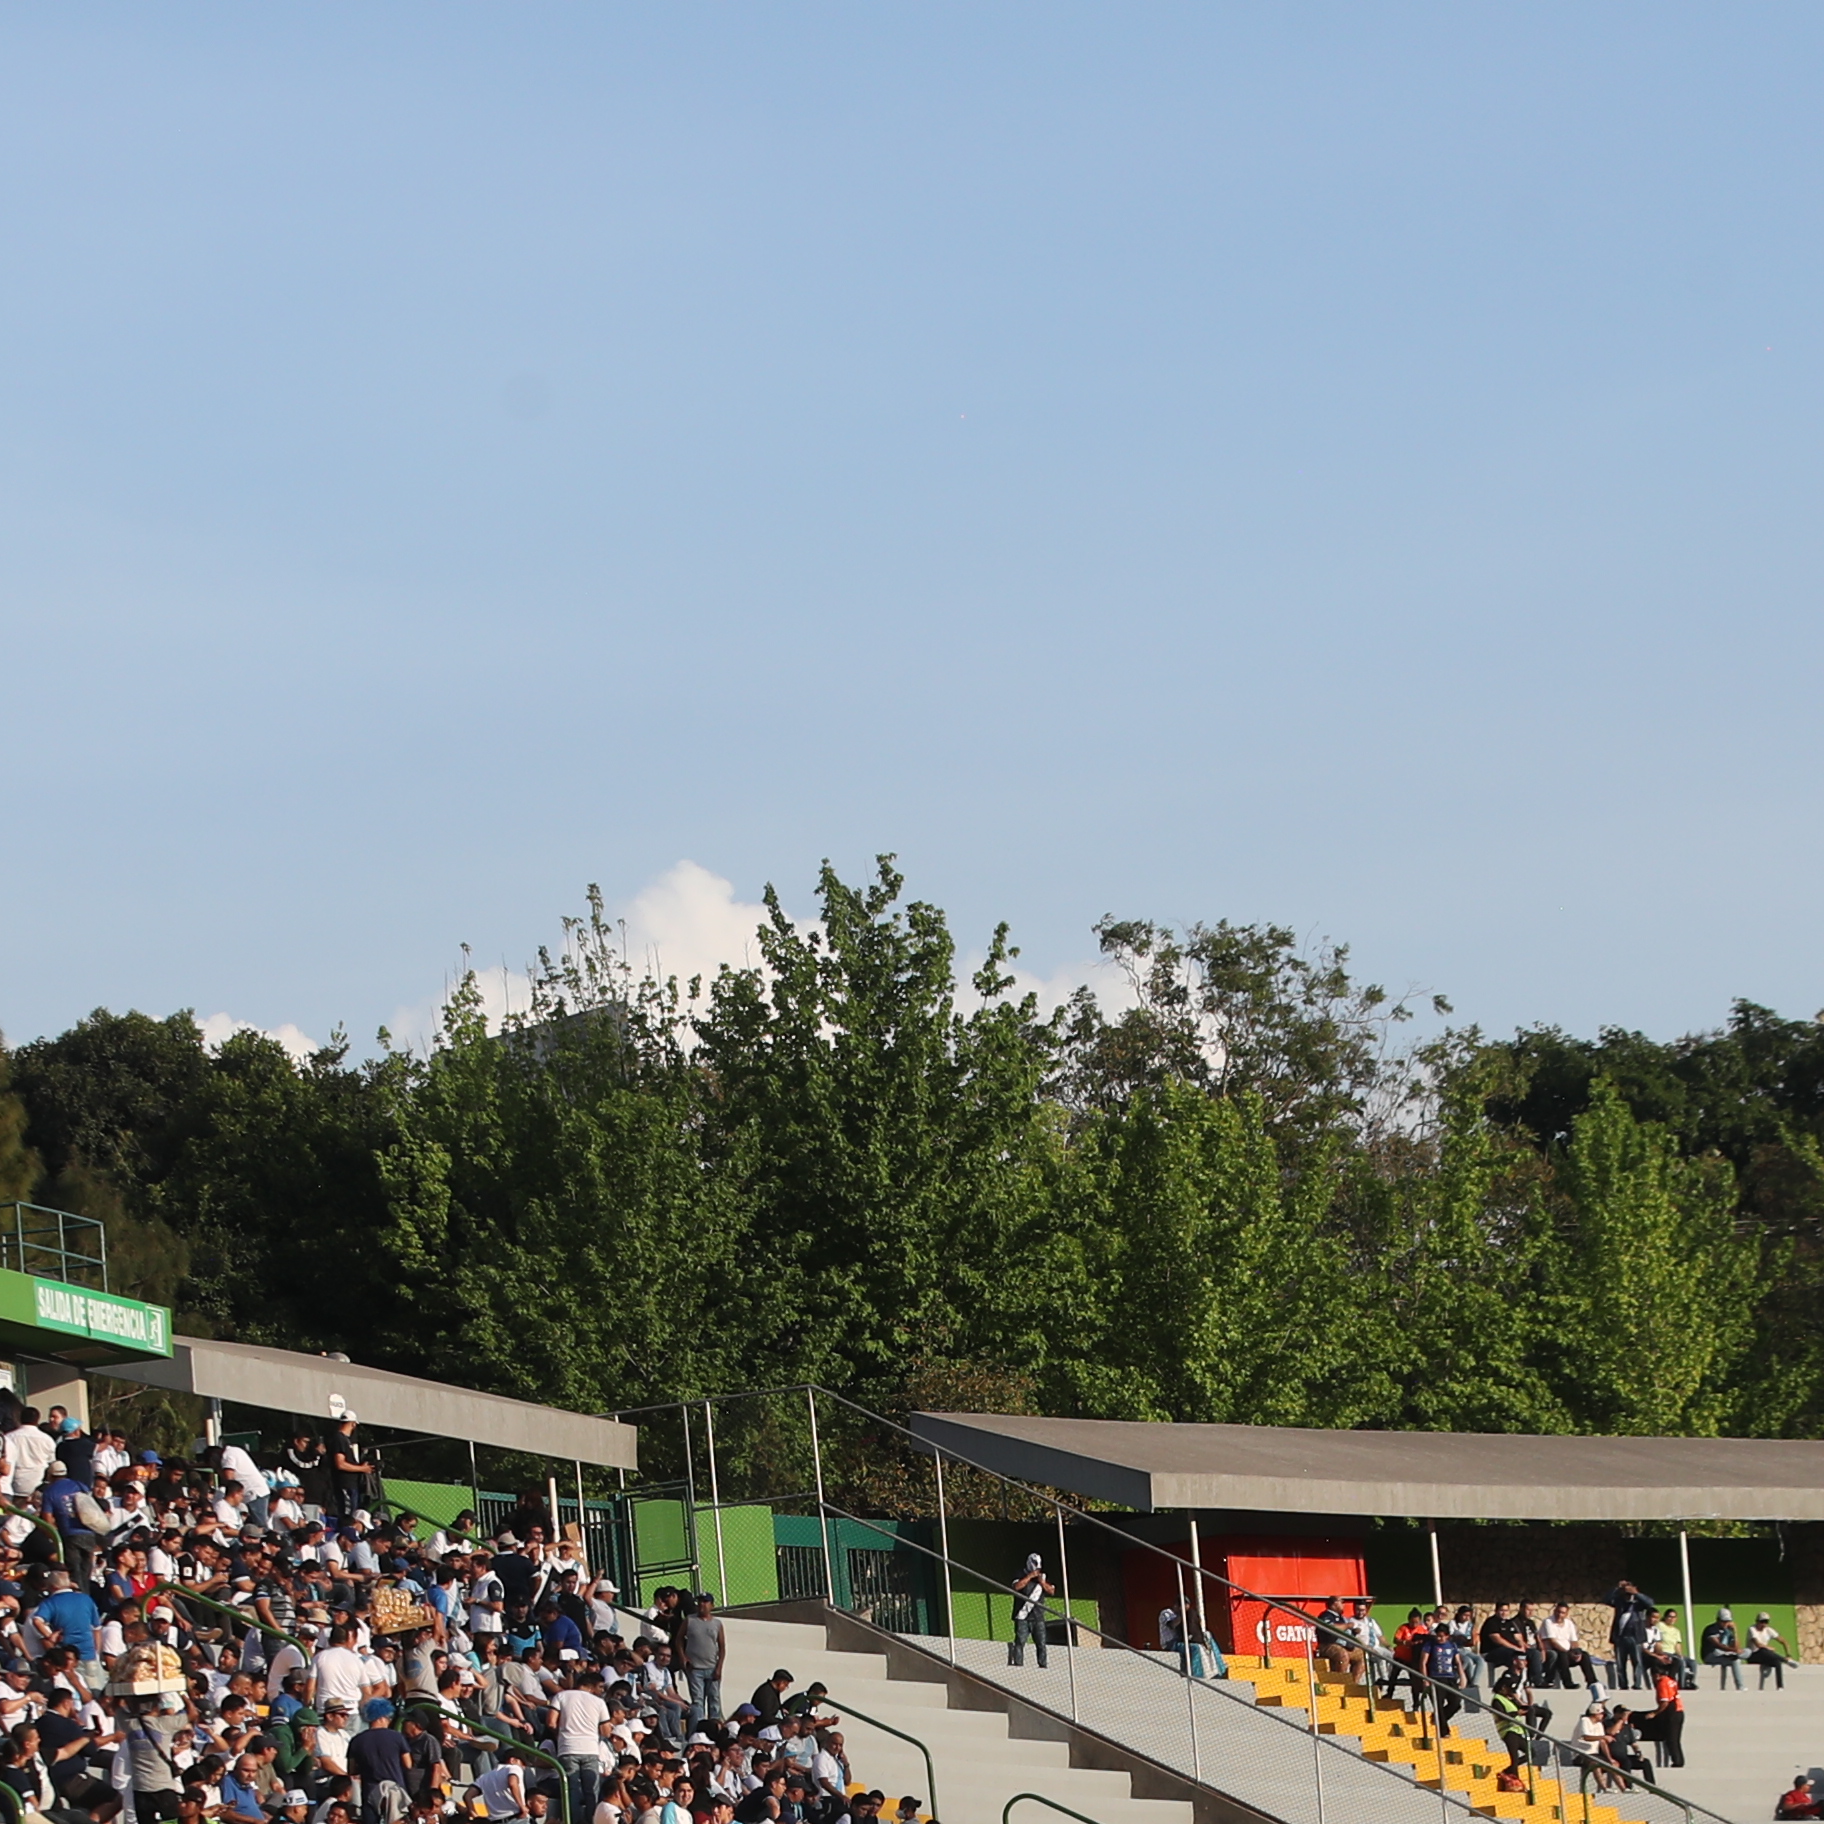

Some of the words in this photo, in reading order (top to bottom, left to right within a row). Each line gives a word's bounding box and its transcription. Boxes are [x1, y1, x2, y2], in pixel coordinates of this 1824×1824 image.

[38, 1286, 73, 1324] SALIDA
[72, 1294, 86, 1327] DE
[87, 1298, 147, 1341] EMERGENCIA
